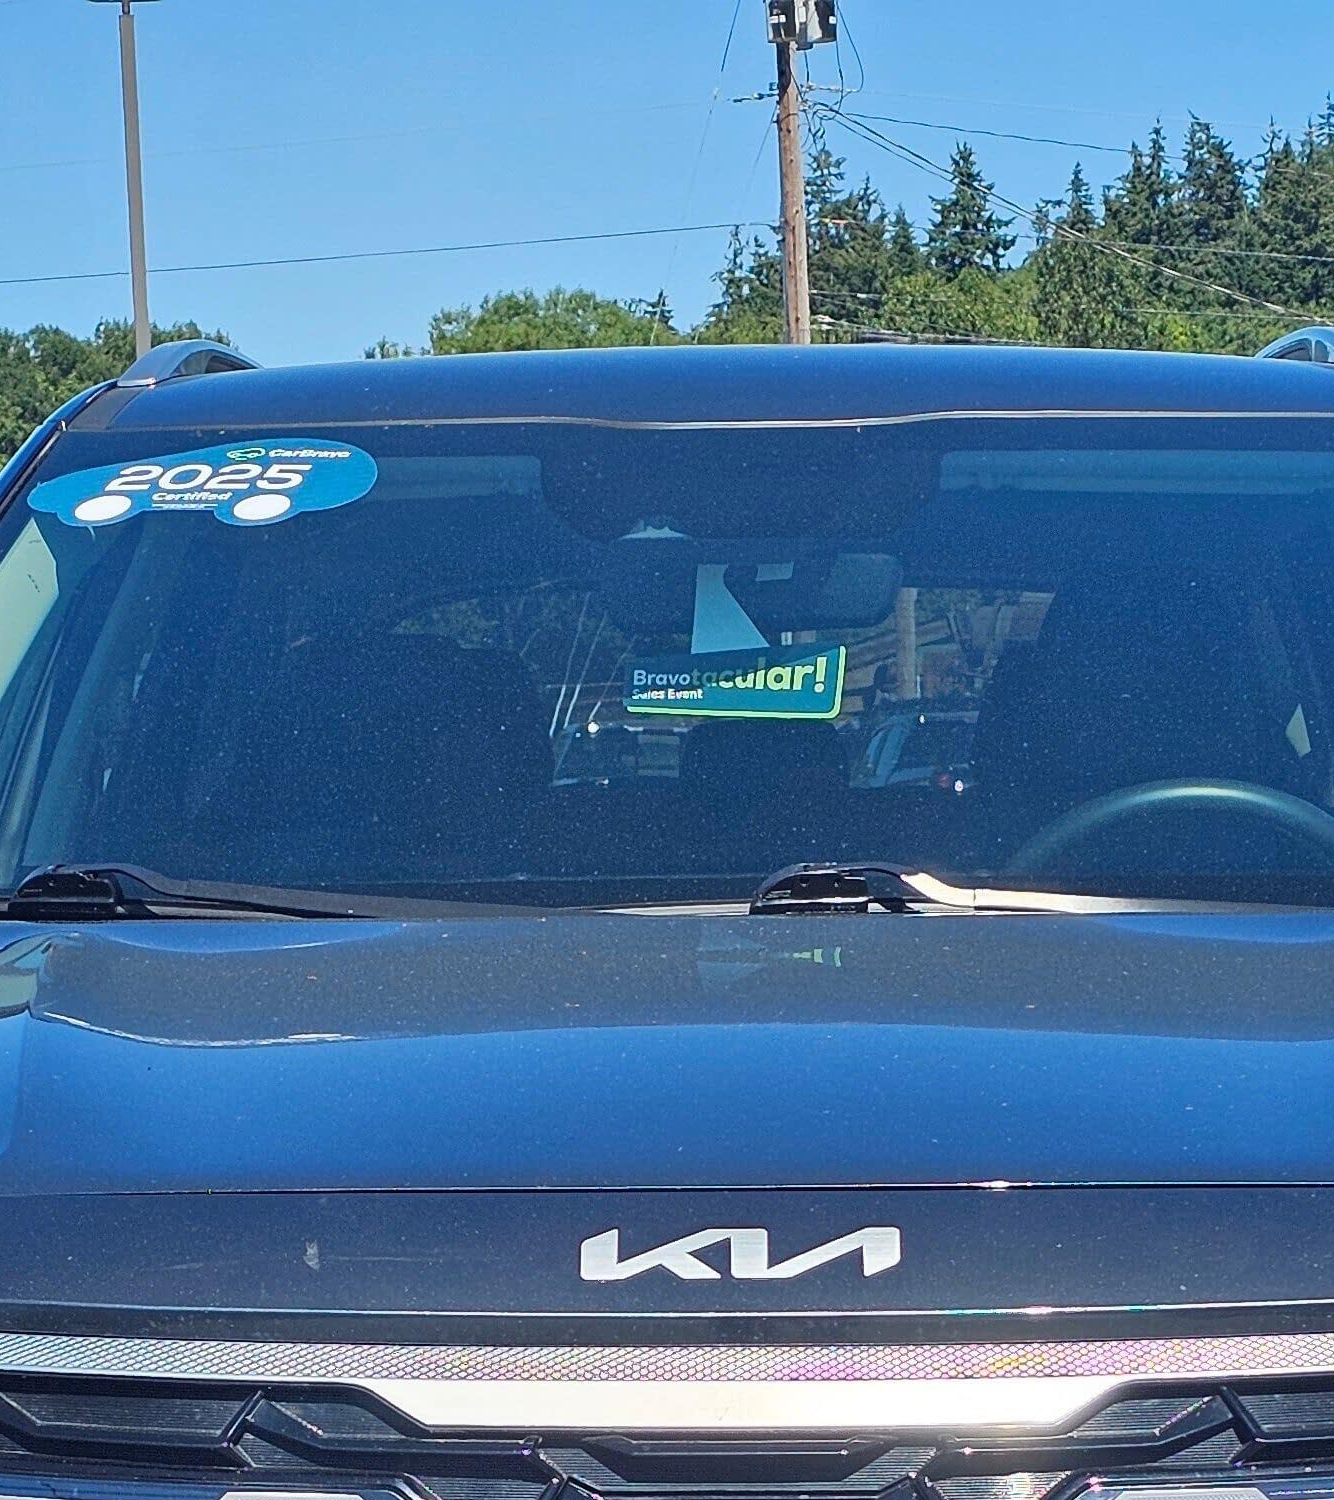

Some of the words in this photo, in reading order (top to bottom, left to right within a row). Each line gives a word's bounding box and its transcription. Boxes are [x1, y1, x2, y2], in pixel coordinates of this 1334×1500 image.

[104, 463, 312, 491] 2025
[667, 688, 703, 700] Event
[580, 1227, 901, 1281] KIA
